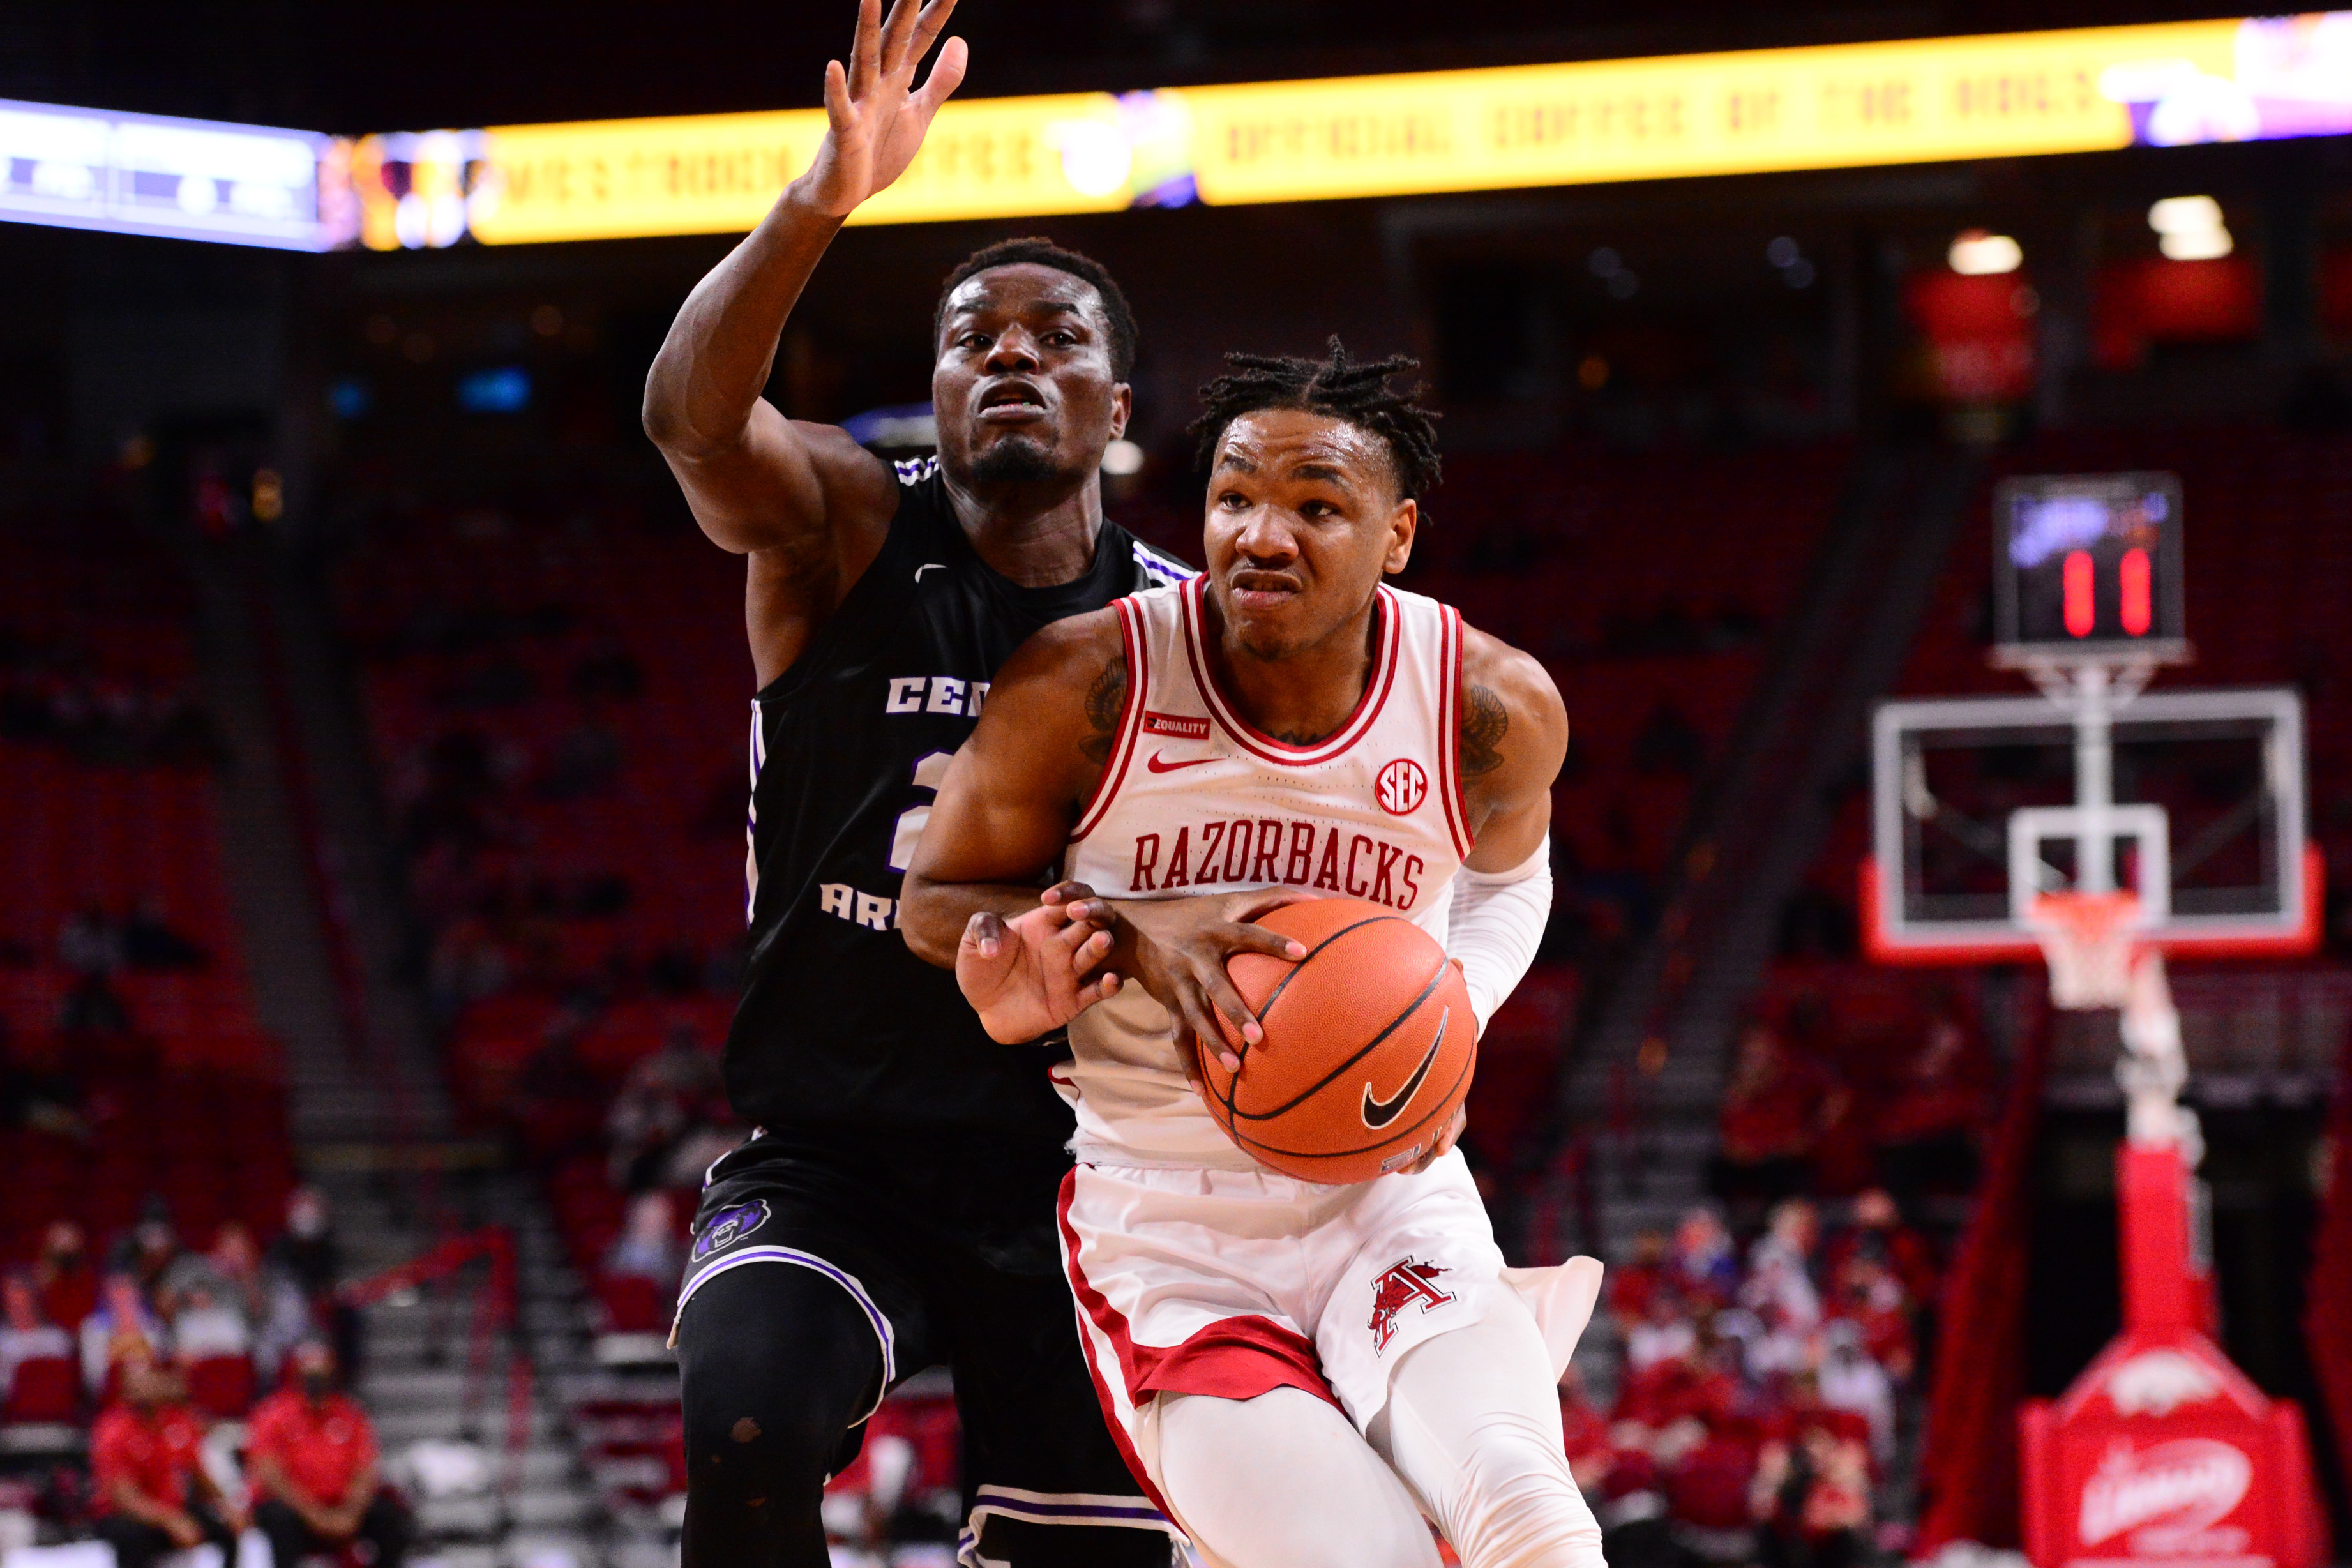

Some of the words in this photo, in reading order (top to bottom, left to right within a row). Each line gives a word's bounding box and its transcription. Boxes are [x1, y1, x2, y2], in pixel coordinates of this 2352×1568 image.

[1154, 718, 1207, 734] EQUALITY
[1380, 761, 1424, 812] SEC
[1129, 820, 1424, 910] RAZORBACKS
